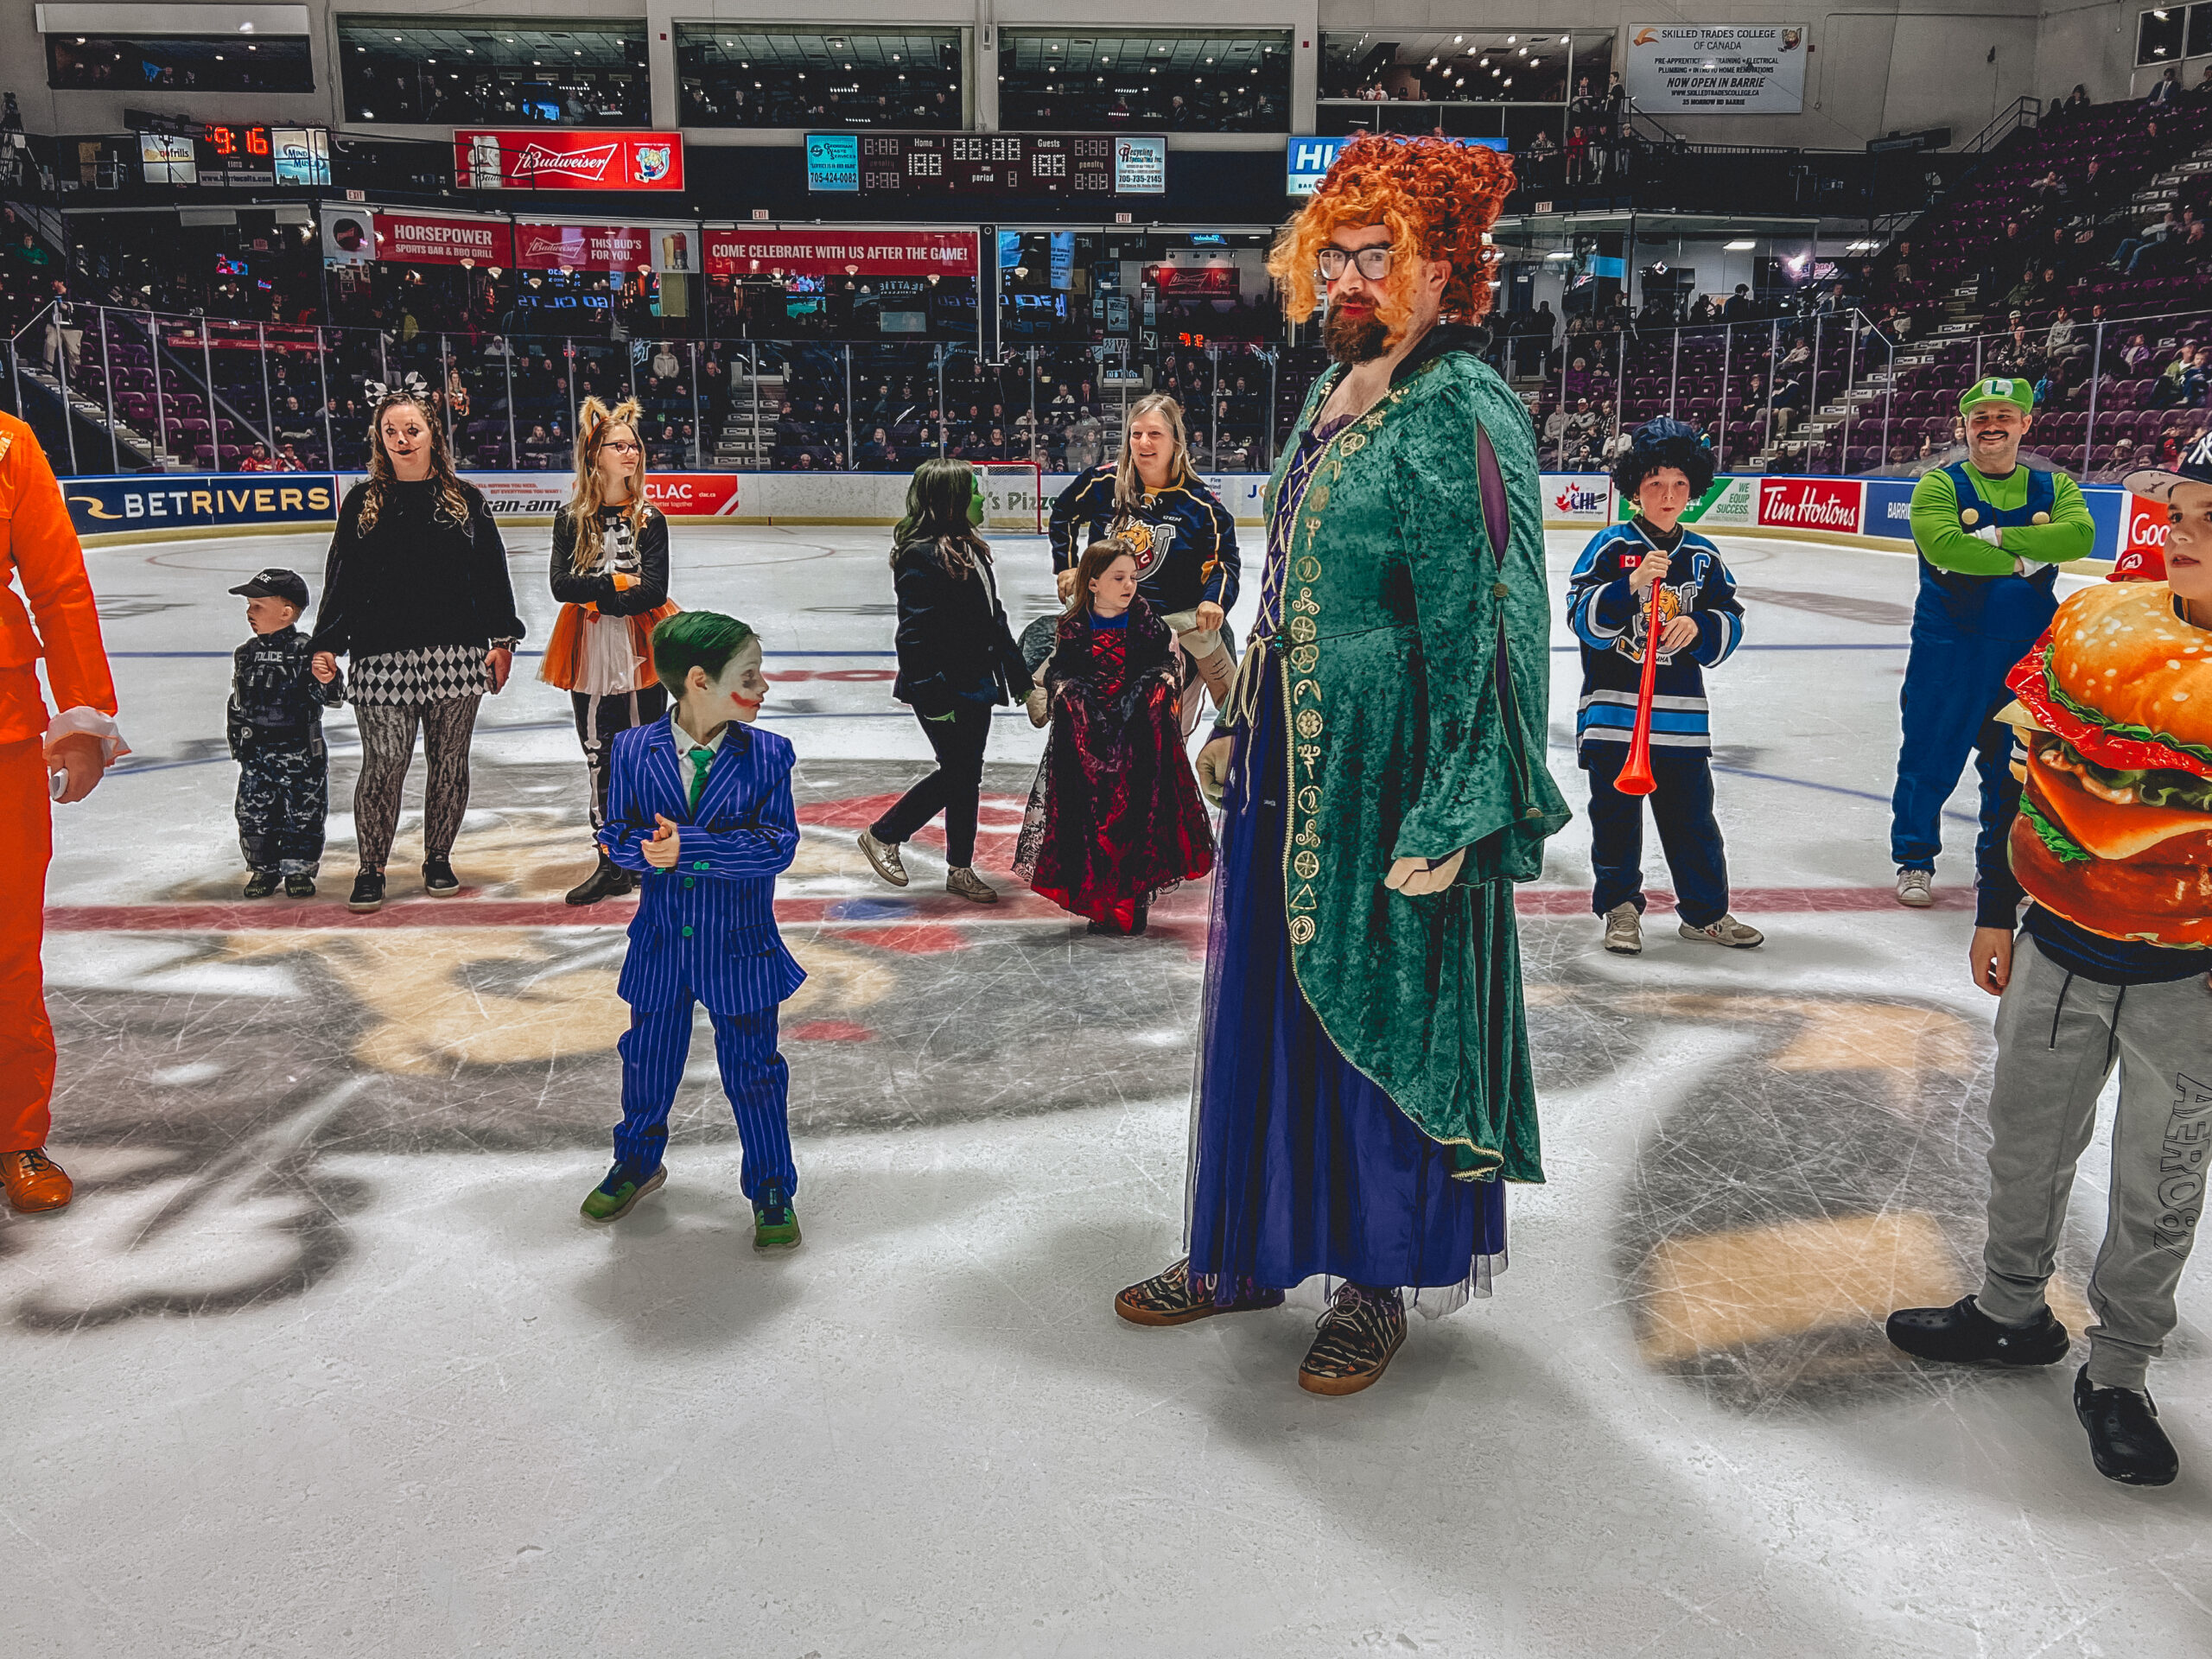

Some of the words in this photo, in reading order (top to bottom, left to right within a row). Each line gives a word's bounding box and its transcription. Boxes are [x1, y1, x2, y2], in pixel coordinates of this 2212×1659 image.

[1662, 29, 1698, 38] SKILLED
[1701, 29, 1734, 38] TRADES
[1737, 29, 1777, 38] COLLEGE
[1694, 41, 1705, 50] OF
[1707, 41, 1742, 50] CANADA
[1667, 78, 1689, 87] NOW
[1691, 78, 1716, 87] OPEN
[1718, 78, 1728, 87] IN
[1730, 78, 1765, 87] BARRIE
[914, 138, 933, 148] Home
[1038, 138, 1061, 148] Guests
[520, 151, 606, 168] Budweiser
[810, 173, 857, 183] 705-424-0082
[972, 174, 994, 183] period
[1118, 175, 1162, 183] 705-735-2145
[348, 190, 363, 200] EXIT
[1536, 202, 1551, 212] EXIT
[753, 210, 768, 219] EXIT
[1117, 213, 1130, 222] EXIT
[394, 224, 493, 245] HORSEPOWER
[591, 238, 612, 250] THIS
[613, 238, 642, 250] BUD'S
[395, 244, 427, 254] SPORTS
[428, 245, 445, 256] BAR
[446, 247, 453, 256] &
[472, 248, 493, 258] GRILL
[591, 250, 609, 260] FOR
[611, 251, 633, 261] YOU.
[712, 244, 746, 257] COME
[748, 244, 813, 258] CELEBRATE
[815, 245, 846, 259] WITH
[849, 245, 864, 259] US
[867, 245, 903, 260] AFTER
[905, 246, 927, 260] THE
[930, 246, 968, 261] GAME!
[1991, 380, 2005, 396] L
[643, 484, 693, 499] CLAC
[1738, 482, 1751, 493] WE
[124, 486, 331, 518] BETRIVERS
[1570, 492, 1598, 510] CHL
[1729, 493, 1750, 504] EQUIP
[1716, 503, 1749, 515] SUCCESS.
[1764, 486, 1796, 520] Tim
[1798, 486, 1856, 527] Hortons
[1691, 553, 1711, 589] C
